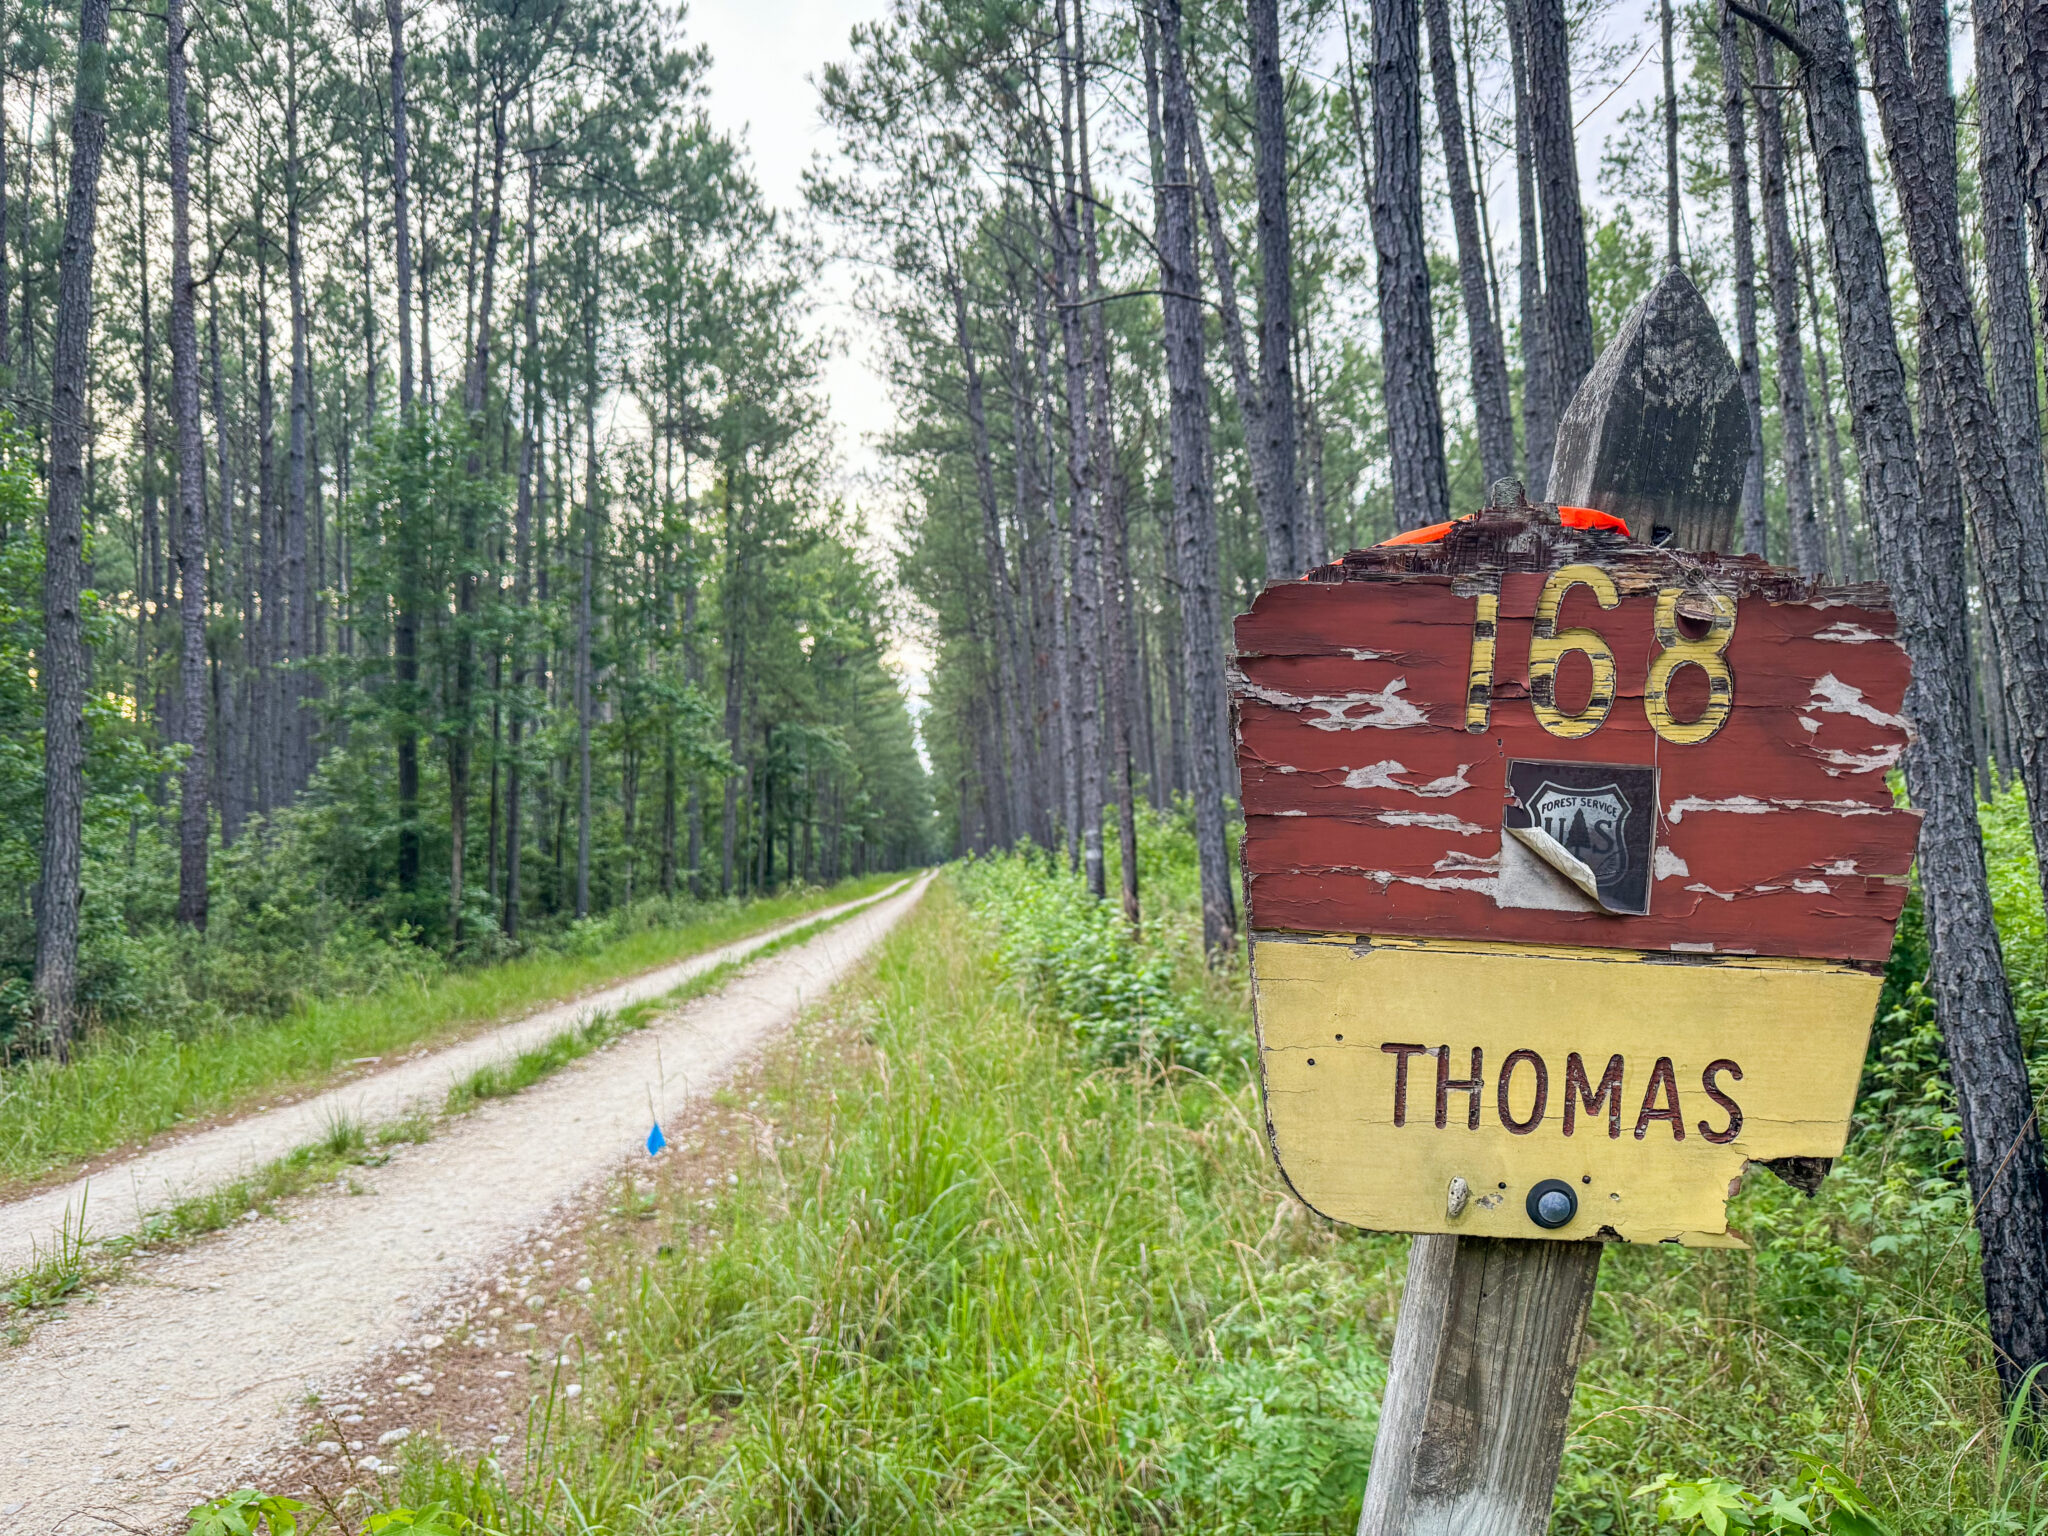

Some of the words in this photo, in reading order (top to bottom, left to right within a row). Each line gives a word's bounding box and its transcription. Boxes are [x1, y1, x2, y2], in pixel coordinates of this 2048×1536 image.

[1456, 564, 1738, 746] 168
[1541, 797, 1577, 815] FOREST
[1580, 797, 1619, 818] SERVICE
[1380, 1042, 1744, 1145] THOMAS
